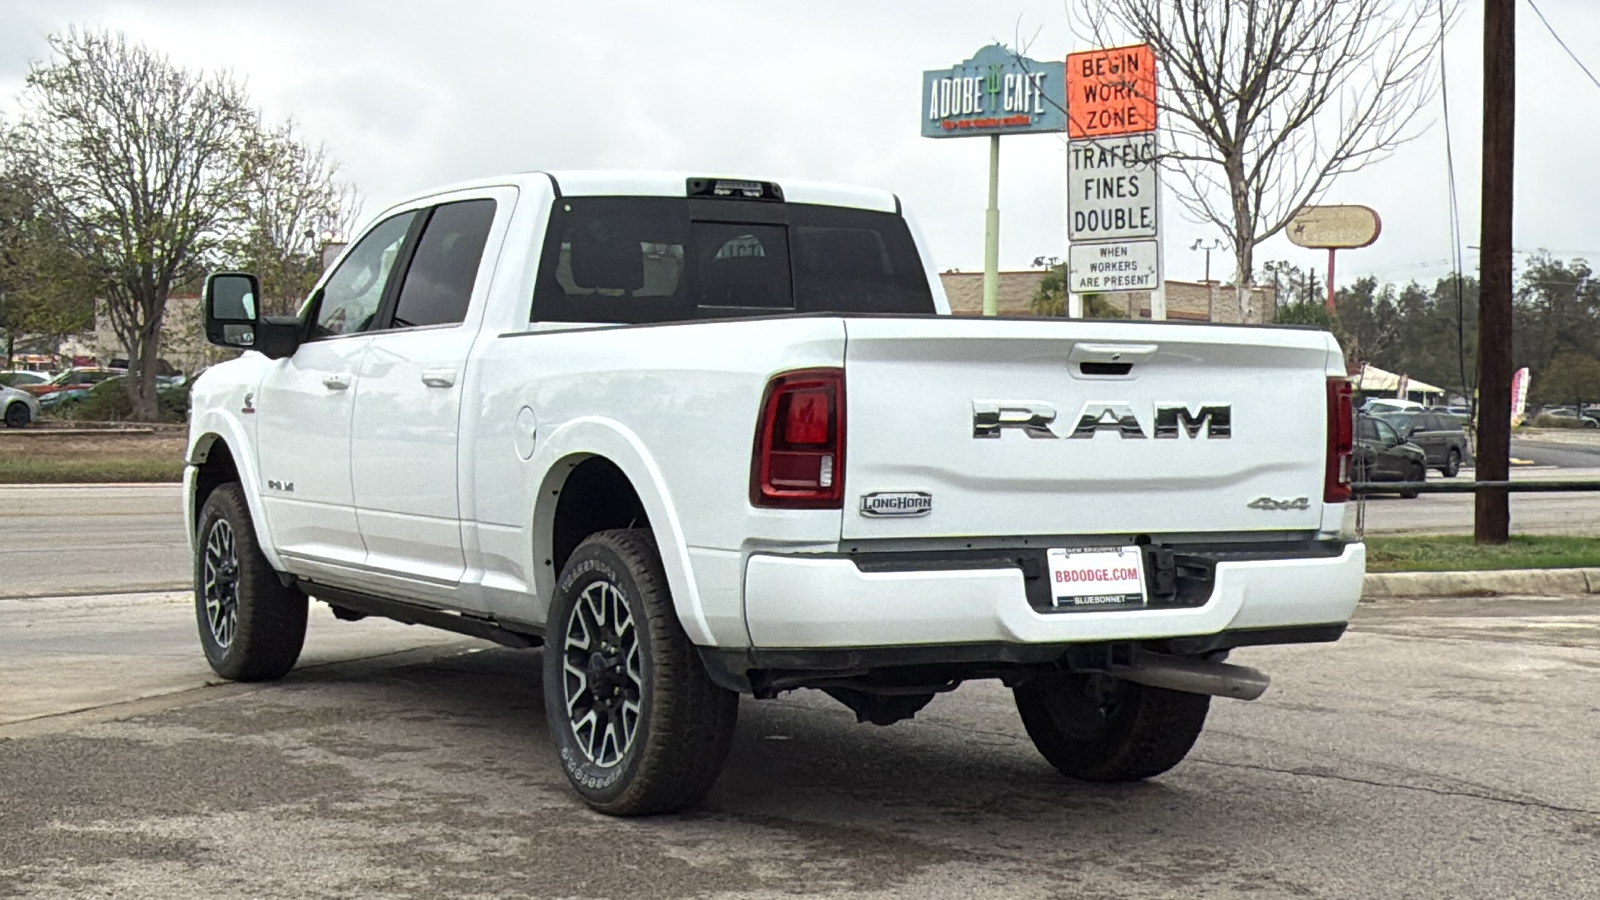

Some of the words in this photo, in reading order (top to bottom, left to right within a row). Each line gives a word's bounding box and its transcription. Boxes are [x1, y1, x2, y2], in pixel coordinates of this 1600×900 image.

[1082, 53, 1139, 78] BEGIN
[929, 76, 984, 120] ADOBE
[1083, 79, 1139, 104] WORK
[1086, 106, 1138, 130] ZONE
[1071, 143, 1152, 170] TRAFFIC
[1084, 175, 1139, 201] FINES
[1075, 206, 1151, 232] DOUBLE
[1100, 246, 1128, 258] WHEN
[1089, 261, 1138, 273] WORKERS
[1079, 276, 1100, 288] ARE
[1103, 274, 1150, 288] PRESENT
[972, 399, 1232, 440] RAM
[1055, 567, 1139, 583] BBDODGE.COM
[1074, 595, 1126, 605] BLUEBONNET
